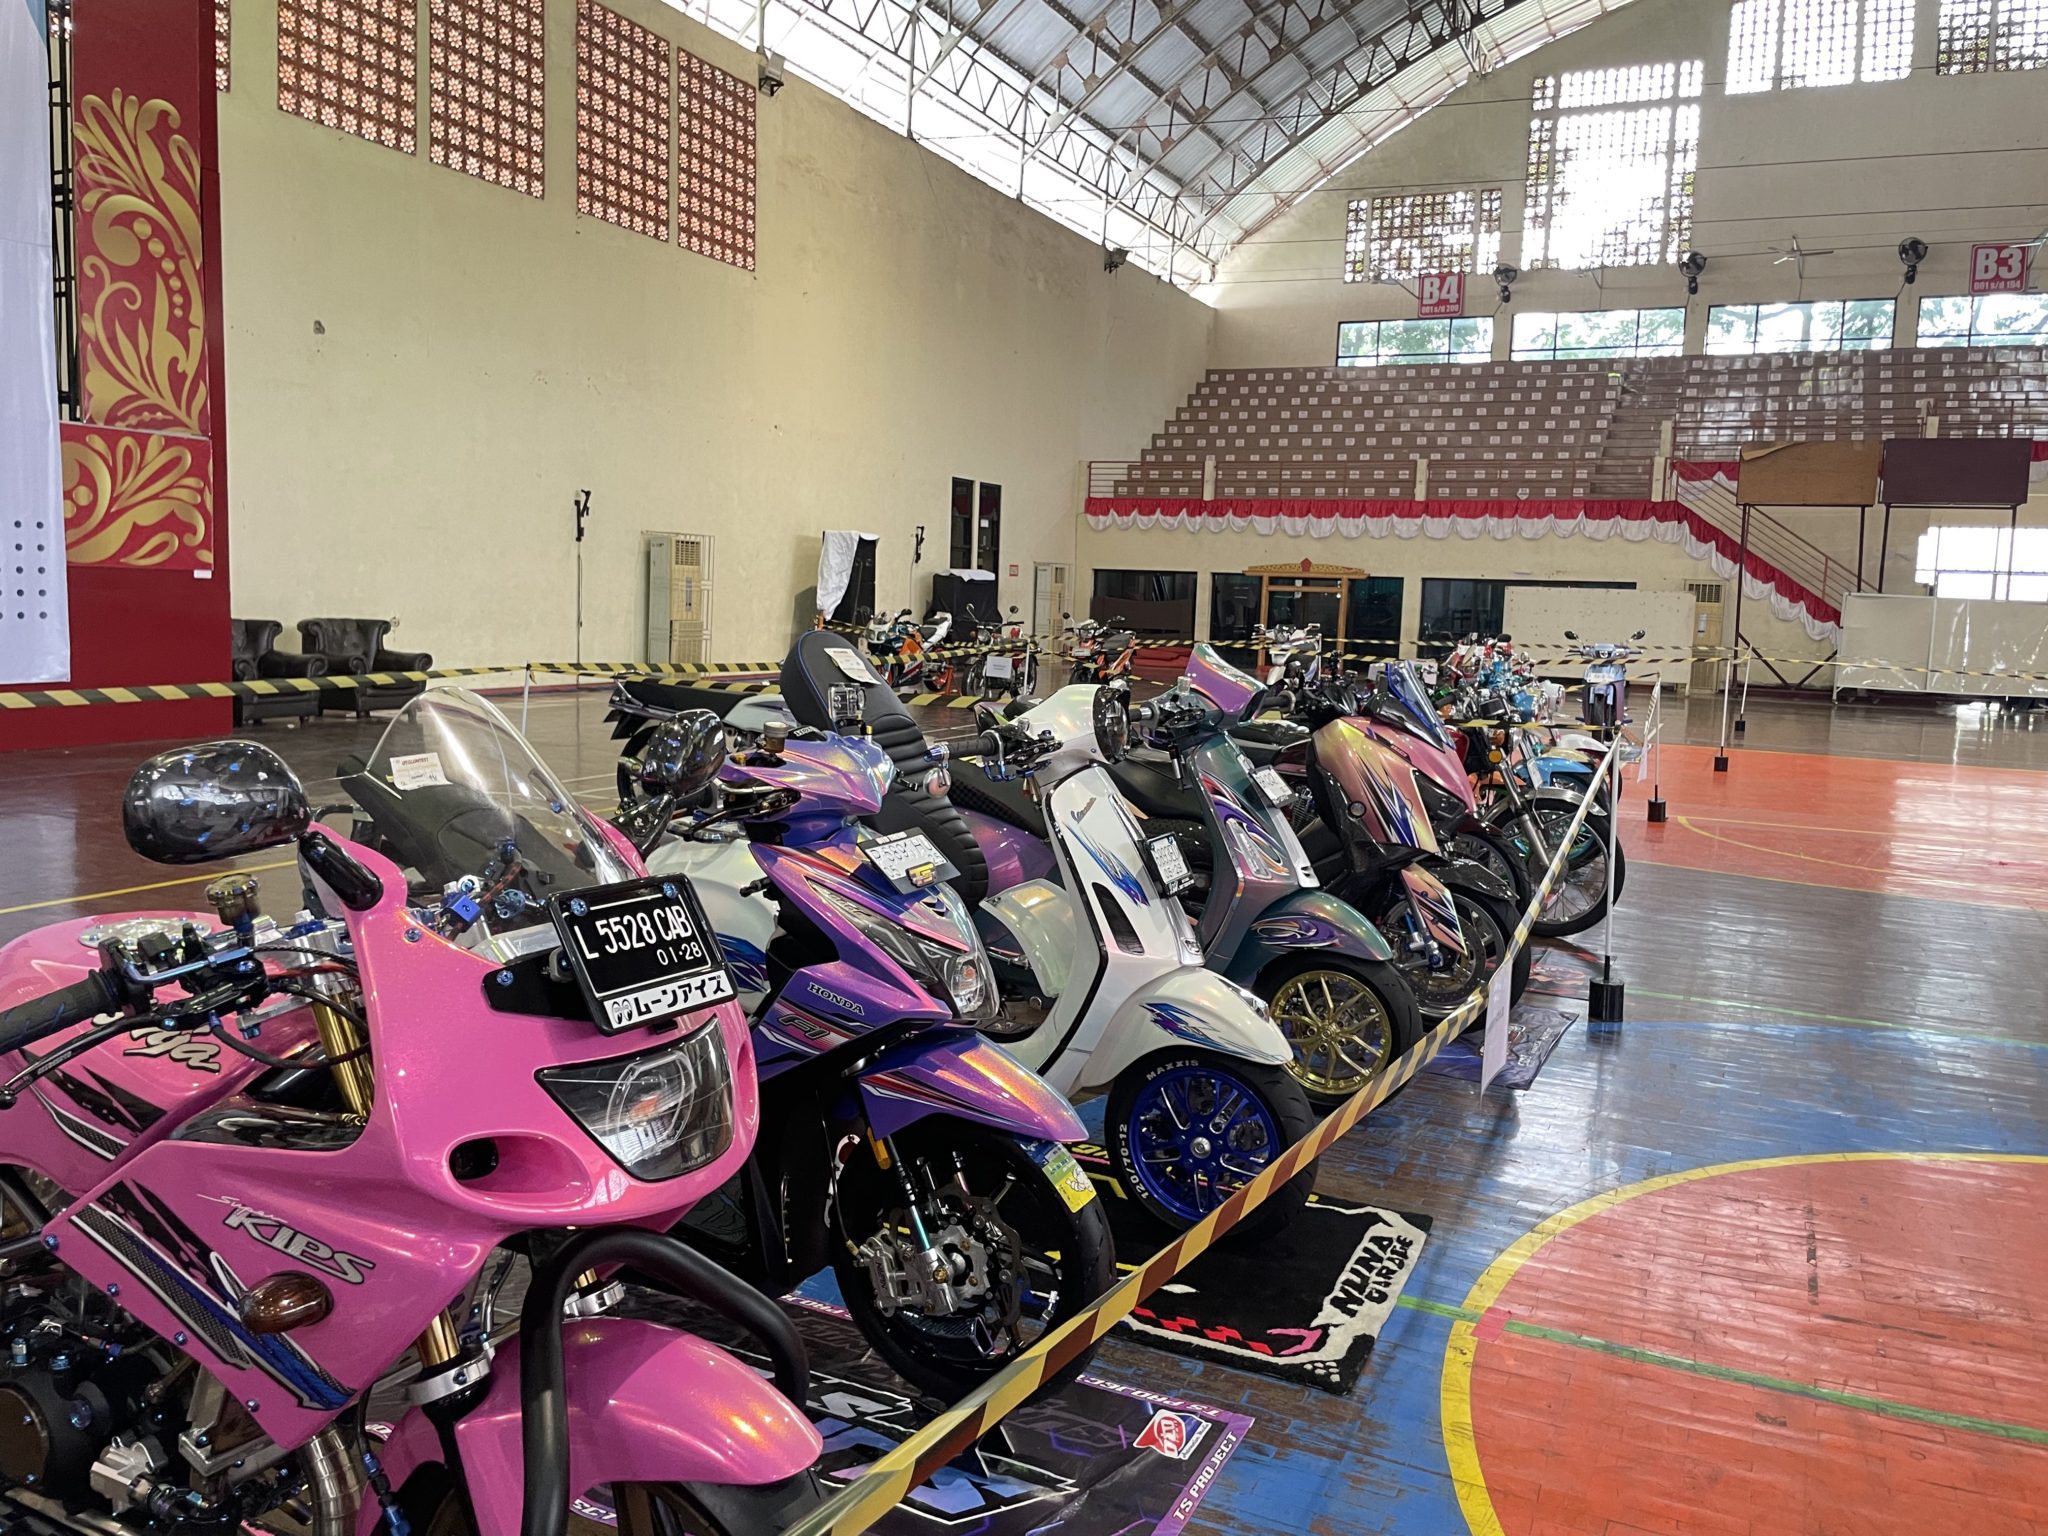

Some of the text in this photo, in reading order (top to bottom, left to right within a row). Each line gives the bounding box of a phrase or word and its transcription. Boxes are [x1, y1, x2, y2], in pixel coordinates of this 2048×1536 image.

[1974, 247, 2023, 280] B3
[1422, 276, 1459, 304] B4
[574, 905, 693, 960] L 5528 CAB
[634, 975, 727, 1017] ムーンアイズ
[808, 981, 865, 1016] HONDA
[1146, 1059, 1199, 1081] MAXXIS
[1119, 1123, 1150, 1199] 120/70-12
[223, 1206, 376, 1285] KIPS
[1364, 1234, 1414, 1304] GARAGE
[1173, 1498, 1193, 1521] TS
[1189, 1432, 1238, 1498] PROJECT
